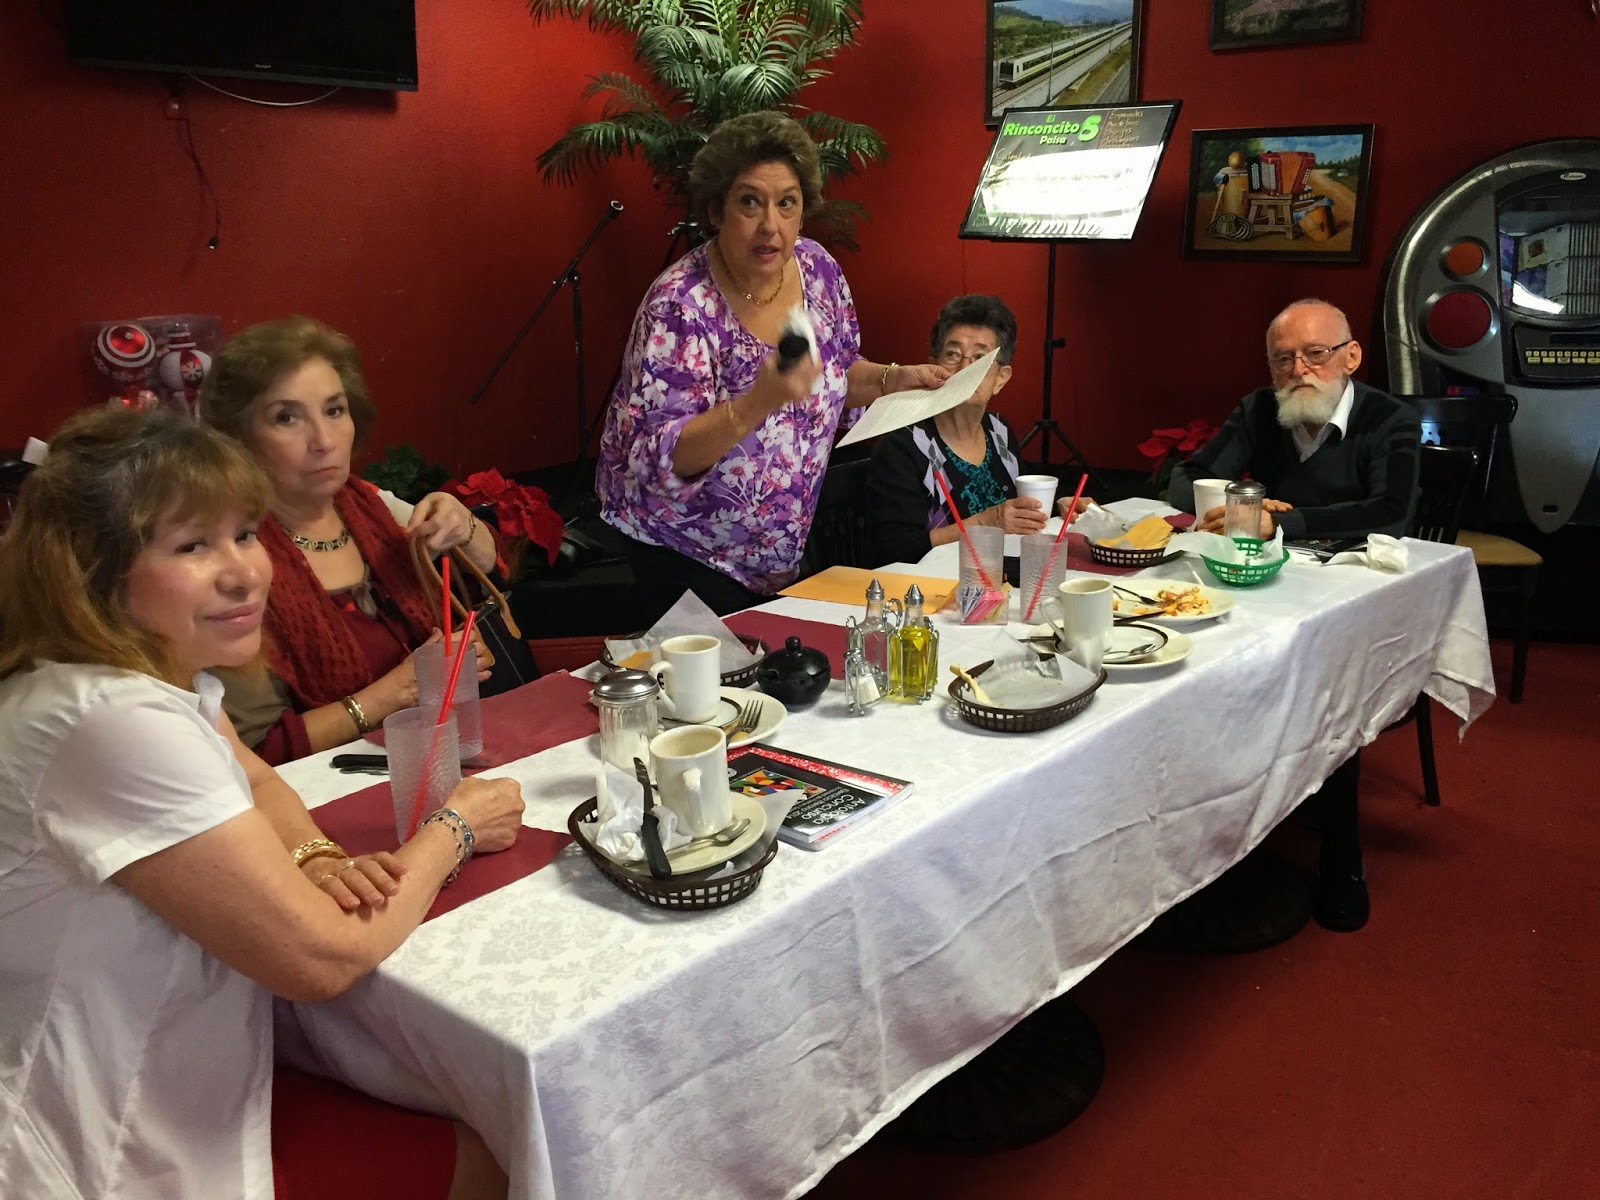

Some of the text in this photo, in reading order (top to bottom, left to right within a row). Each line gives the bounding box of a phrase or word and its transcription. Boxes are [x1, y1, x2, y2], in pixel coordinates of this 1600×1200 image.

[1003, 122, 1079, 135] Rinconcito
[1040, 135, 1067, 145] Paisa
[801, 794, 854, 820] Concurso
[812, 797, 865, 825] Antología
